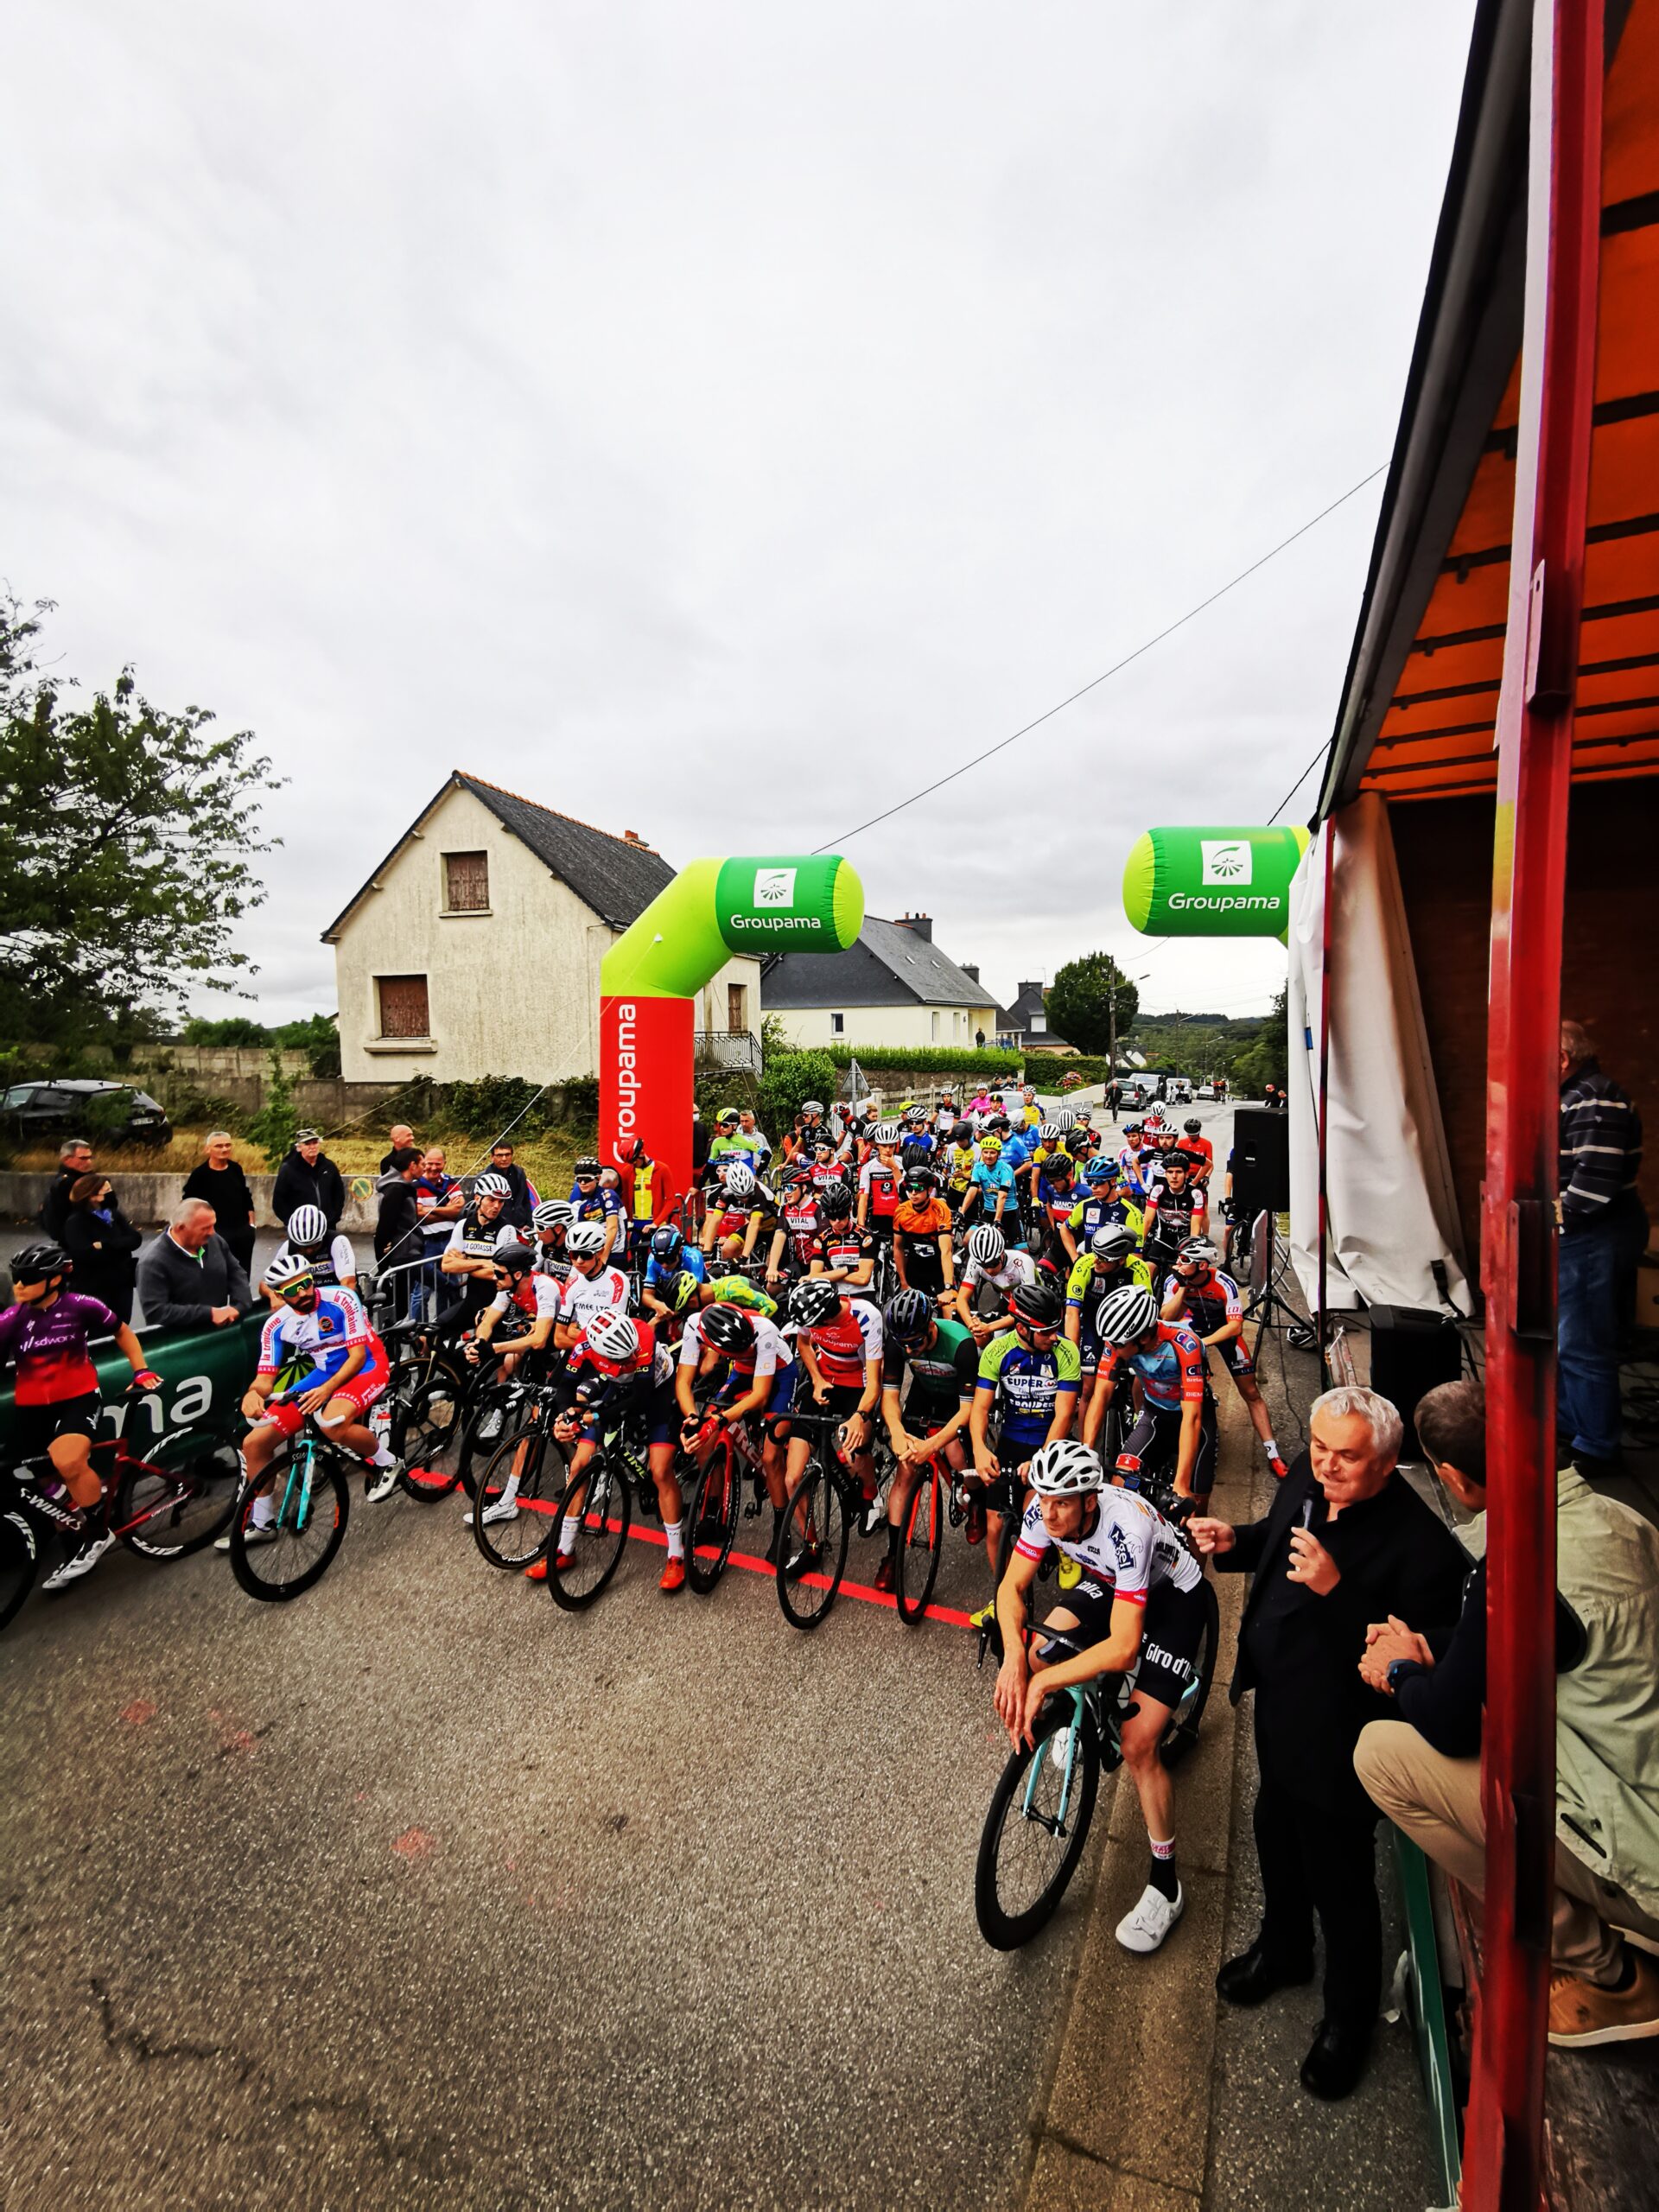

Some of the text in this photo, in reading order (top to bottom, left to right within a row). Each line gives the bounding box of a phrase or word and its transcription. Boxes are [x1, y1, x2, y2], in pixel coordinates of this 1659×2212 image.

[1168, 893, 1281, 912] Groupama
[730, 913, 822, 931] Groupama
[813, 1332, 859, 1348] Groupama
[1007, 1377, 1043, 1388] SUPER
[622, 1450, 648, 1480] TIME
[20, 1486, 83, 1531] S-WORKS
[1109, 1529, 1135, 1571] Argel
[1146, 1643, 1173, 1669] Giro
